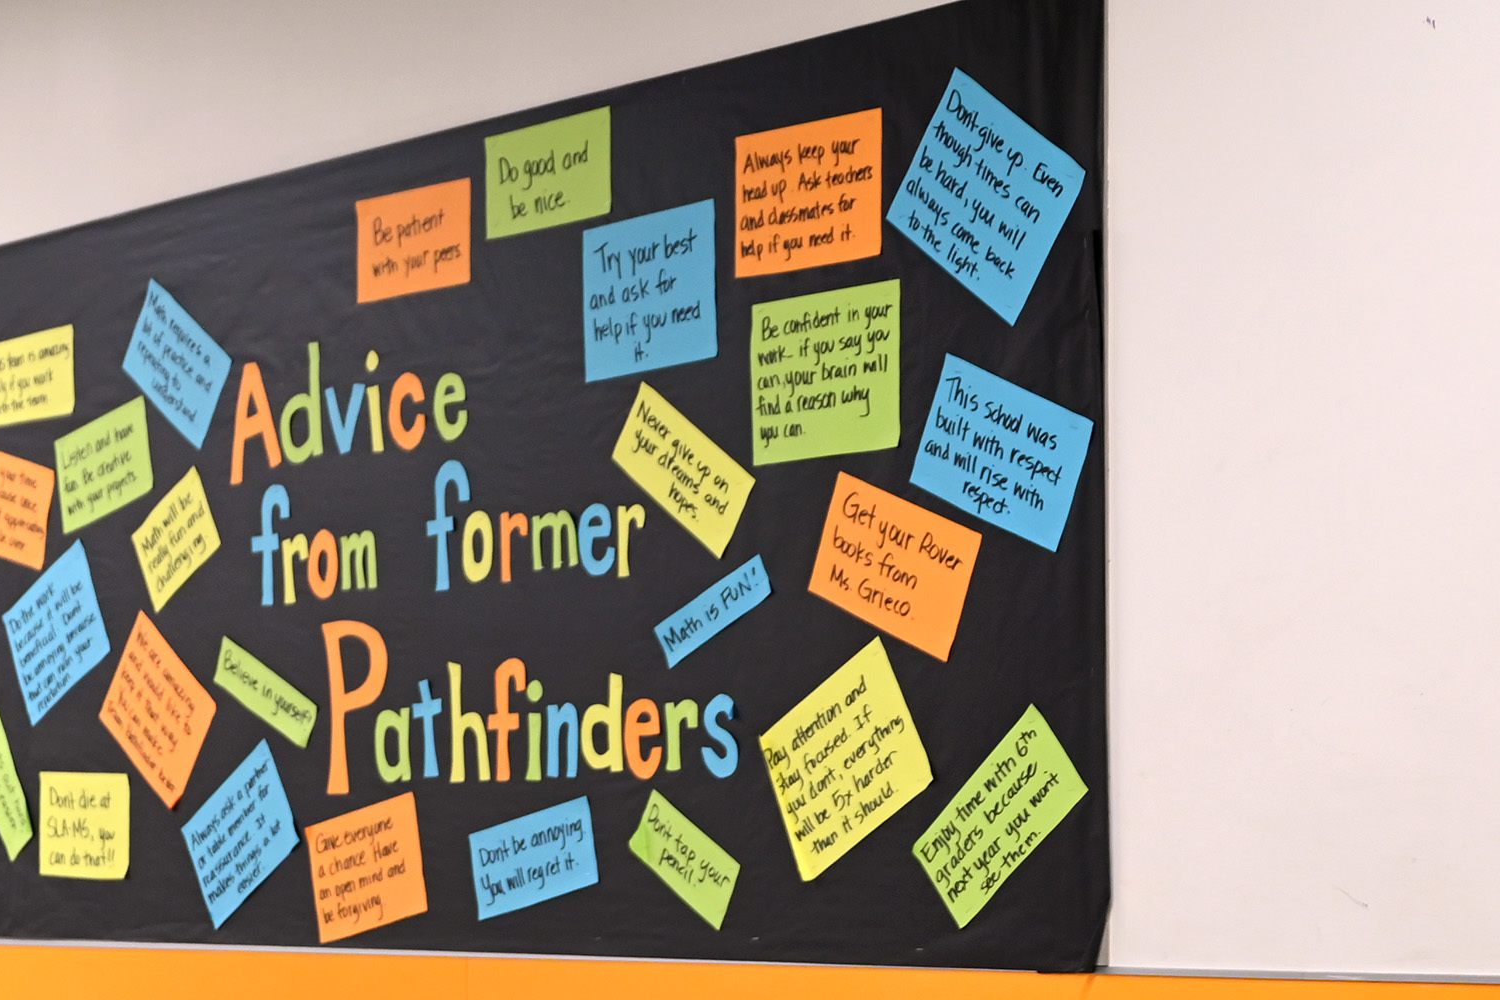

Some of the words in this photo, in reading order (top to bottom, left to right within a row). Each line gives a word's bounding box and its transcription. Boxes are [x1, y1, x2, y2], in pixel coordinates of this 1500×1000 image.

[499, 156, 519, 184] Do
[522, 149, 556, 190] good
[562, 139, 589, 170] and
[742, 149, 793, 174] Always
[796, 143, 825, 165] keep
[831, 138, 860, 167] your
[742, 180, 767, 203] head
[797, 171, 821, 191] Ask
[825, 165, 873, 188] teachers
[933, 119, 973, 168] though
[975, 157, 1011, 199] times
[1014, 195, 1041, 224] can
[972, 121, 1004, 152] give
[1032, 161, 1065, 198] Even
[509, 194, 528, 219] be
[740, 209, 764, 231] and
[768, 200, 834, 225] classmates
[837, 193, 857, 212] for
[919, 144, 934, 172] be
[970, 198, 993, 228] you
[998, 222, 1027, 251] will
[373, 216, 393, 246] Be
[397, 209, 444, 248] patient
[593, 241, 622, 279] Try
[628, 241, 660, 276] your
[663, 228, 698, 259] best
[740, 239, 763, 261] help
[768, 233, 781, 253] if
[782, 237, 803, 261] you
[808, 226, 834, 247] need
[905, 177, 951, 227] always
[950, 221, 980, 255] come
[984, 250, 1016, 280] back
[908, 215, 921, 233] to
[920, 229, 942, 253] the
[946, 248, 981, 281] light.
[372, 256, 398, 277] with
[404, 249, 429, 278] your
[434, 243, 461, 273] peers
[589, 285, 616, 310] and
[621, 278, 649, 304] ask
[655, 268, 677, 295] for
[593, 317, 623, 344] help
[626, 312, 638, 336] if
[642, 312, 667, 343] you
[672, 300, 701, 323] need
[761, 315, 780, 341] Be
[783, 307, 841, 335] confident
[847, 302, 860, 323] in
[864, 304, 894, 329] your
[799, 338, 811, 357] if
[813, 339, 836, 366] you
[838, 334, 862, 356] say
[866, 329, 891, 354] you
[634, 341, 649, 362] it.
[785, 370, 817, 398] your
[821, 356, 858, 380] brain
[862, 353, 889, 375] will
[230, 341, 467, 485] Advice
[755, 393, 781, 417] find
[784, 400, 794, 414] a
[797, 391, 837, 413] reason
[841, 385, 871, 418] why
[945, 376, 980, 412] This
[983, 401, 1025, 434] school
[1026, 422, 1059, 451] was
[636, 400, 672, 439] Never
[671, 438, 695, 466] give
[697, 460, 711, 484] up
[713, 473, 730, 494] on
[760, 424, 779, 448] you
[935, 404, 971, 442] built
[972, 429, 1004, 460] with
[1009, 447, 1063, 486] respect
[632, 429, 660, 454] your
[657, 449, 701, 494] dreams
[703, 491, 730, 515] and
[924, 439, 954, 461] and
[953, 452, 978, 474] will
[979, 465, 1009, 491] rise
[1012, 483, 1045, 512] with
[962, 480, 1011, 515] respect.
[251, 484, 378, 605] from
[426, 459, 645, 591] former
[832, 525, 874, 567] books
[877, 552, 918, 590] from
[842, 491, 877, 529] Get
[876, 521, 915, 550] your
[918, 531, 964, 571] Rover
[663, 617, 703, 652] Math
[704, 604, 719, 621] is
[720, 566, 758, 609] FUN!
[321, 619, 738, 795] Pathfinders
[763, 747, 790, 770] Pay
[791, 702, 842, 751] attention
[845, 675, 867, 707] and
[776, 768, 804, 795] stay
[854, 704, 873, 730] If
[787, 797, 807, 823] you
[844, 715, 905, 770] everything
[795, 822, 816, 842] will
[814, 809, 831, 824] be
[831, 790, 854, 811] 5x
[853, 751, 898, 793] harder
[920, 820, 962, 863] Enjoy
[955, 790, 986, 822] time
[984, 757, 1017, 793] with
[1016, 728, 1038, 758] 6th
[935, 825, 984, 888] graders
[983, 761, 1038, 824] because
[512, 836, 527, 854] be
[811, 831, 838, 855] than
[842, 815, 853, 833] it
[947, 866, 974, 903] next
[973, 837, 1001, 877] year
[1005, 808, 1031, 842] you
[480, 874, 506, 906] You
[506, 867, 525, 890] will
[527, 856, 560, 889] regret
[565, 852, 579, 870] it.
[698, 860, 730, 888] your
[980, 871, 1001, 895] see
